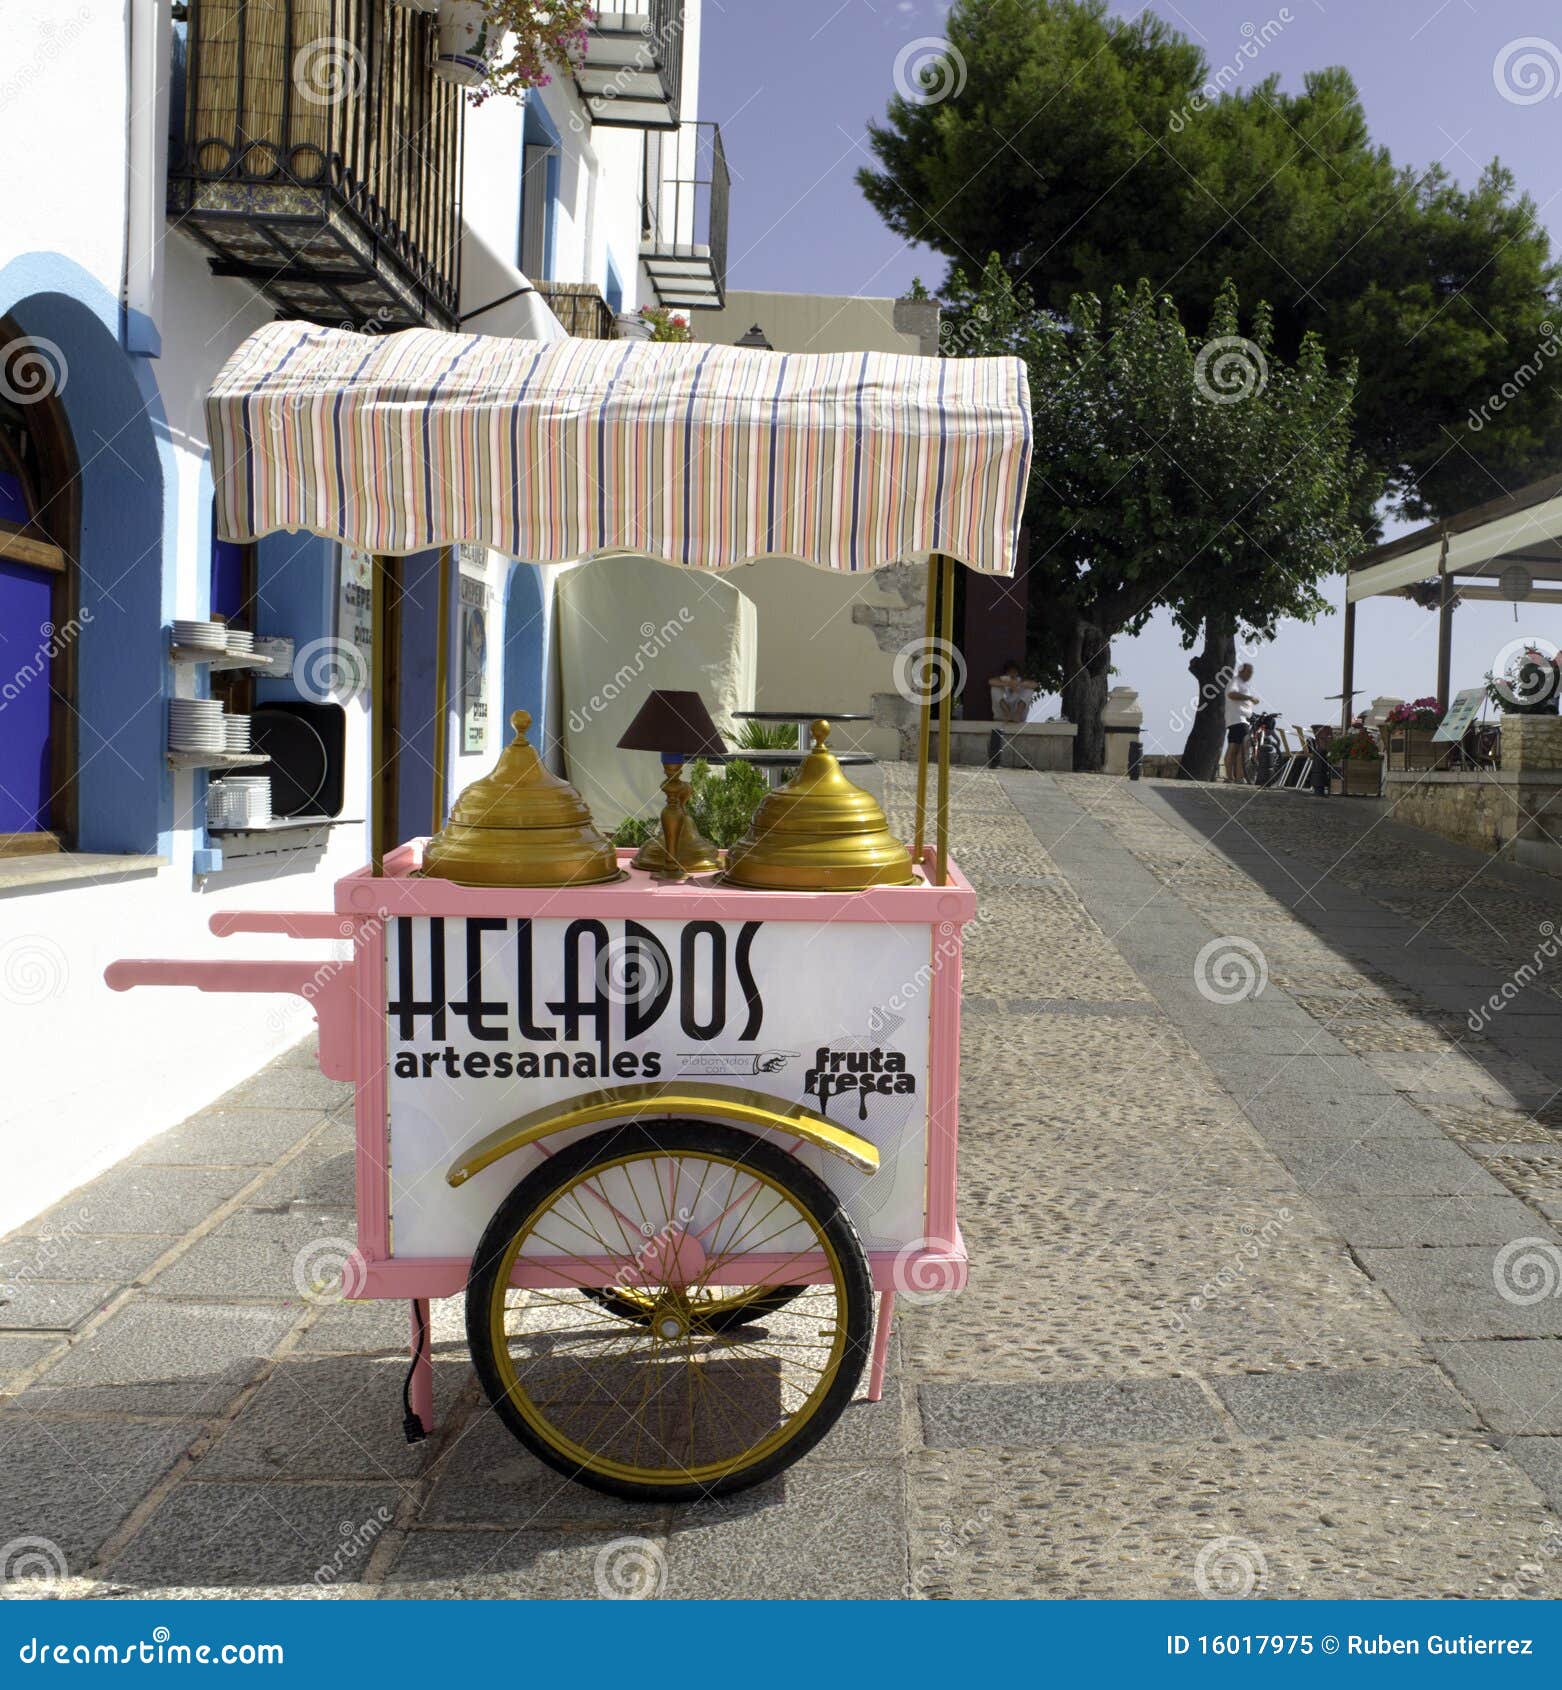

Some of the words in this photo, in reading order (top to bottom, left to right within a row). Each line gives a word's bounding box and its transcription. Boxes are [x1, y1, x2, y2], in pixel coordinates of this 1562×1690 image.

[388, 917, 764, 1041] HELADOS
[395, 1047, 661, 1079] artesanales
[682, 1054, 752, 1066] elaborados
[816, 1047, 906, 1073] fruta
[804, 1069, 916, 1097] fresca
